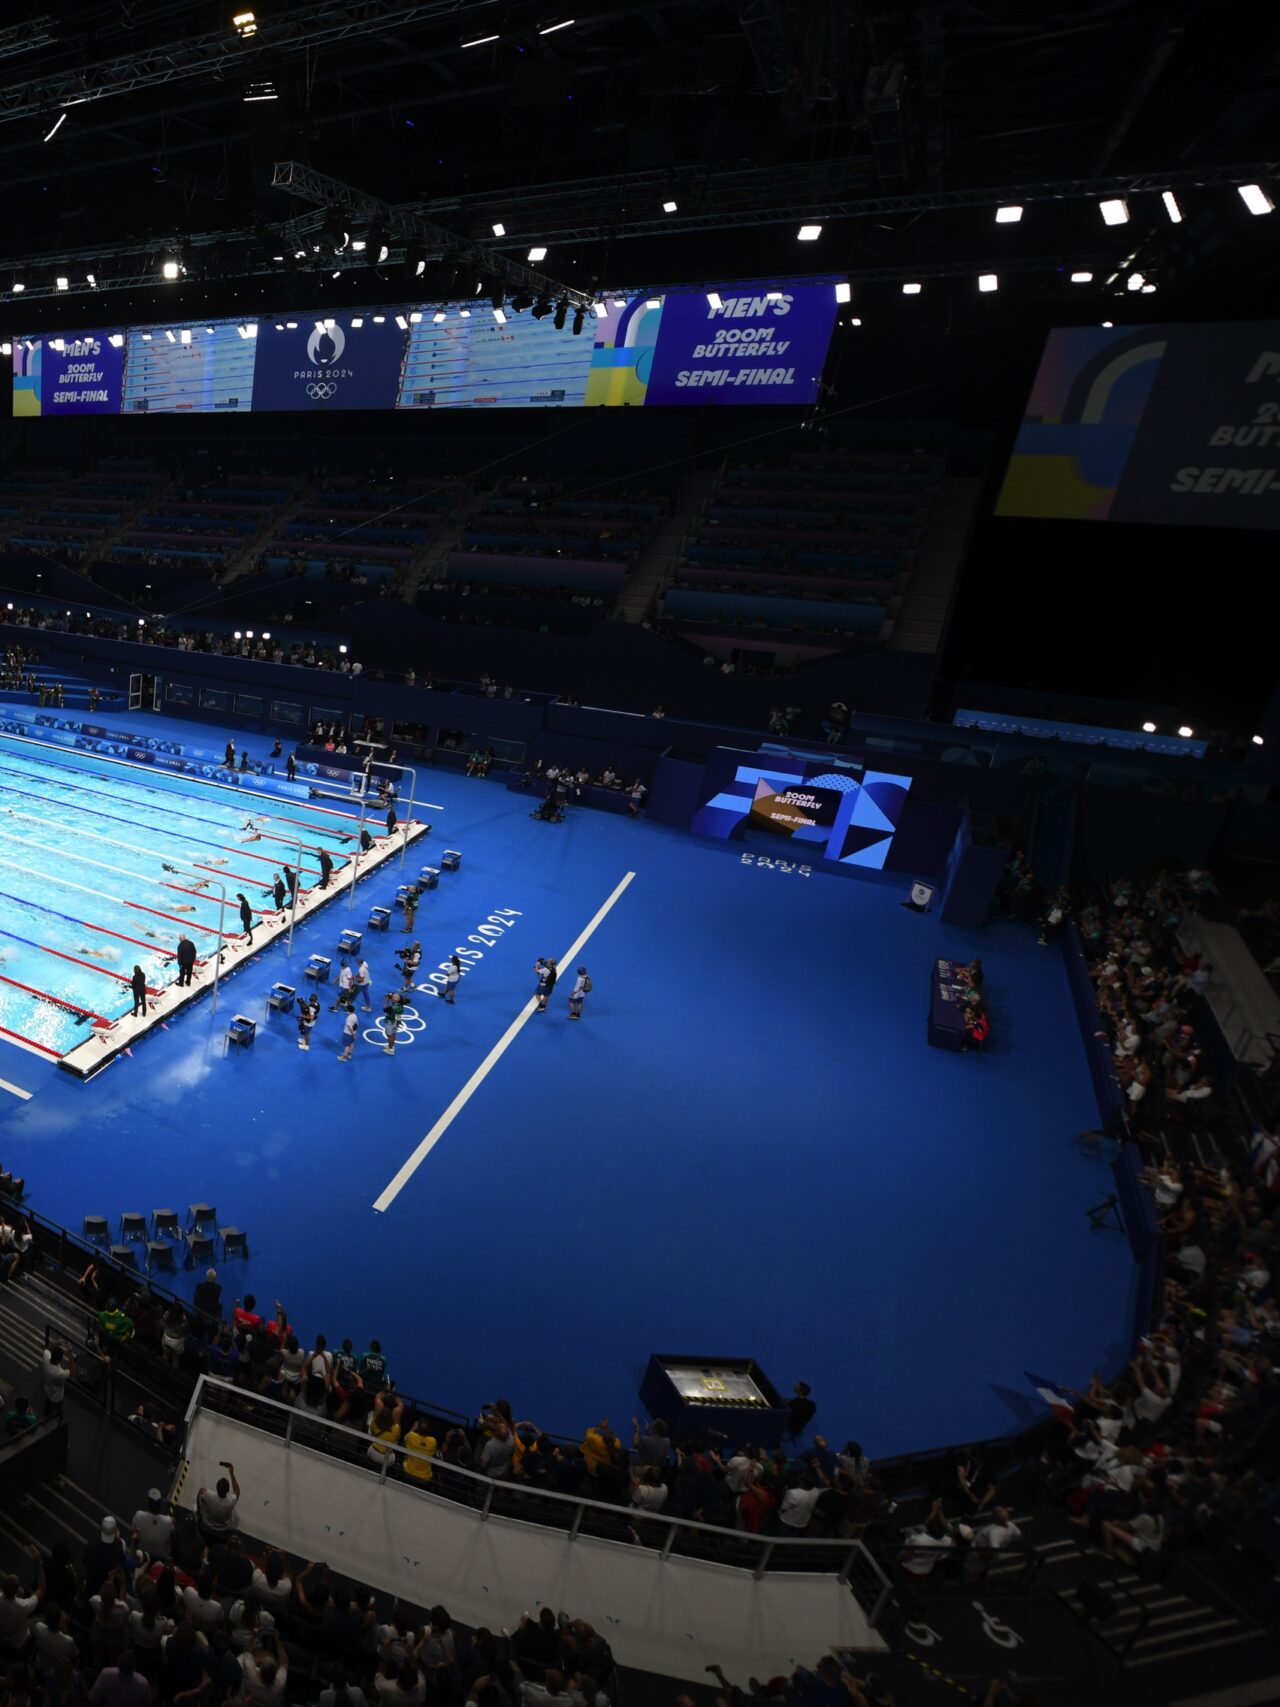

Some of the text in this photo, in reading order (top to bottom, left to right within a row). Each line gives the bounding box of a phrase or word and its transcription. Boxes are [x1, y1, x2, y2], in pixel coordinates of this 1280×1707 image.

[707, 295, 794, 319] MEN'S
[713, 327, 775, 343] 200M
[62, 341, 101, 357] MEN'S
[692, 341, 790, 358] BUTTERFLY
[67, 363, 95, 374] 200M
[294, 369, 353, 379] PARIS 2024
[59, 372, 103, 383] BUTTERFLY
[675, 367, 795, 387] SEMI-FINAL
[53, 390, 108, 403] SEMI-FINAL
[1208, 425, 1280, 447] BUT
[774, 796, 822, 810] BUTTERFLY
[785, 791, 815, 802] 200M
[770, 812, 816, 826] SEMI-FINAL
[742, 853, 812, 872] PARIS
[416, 908, 523, 997] PARIS 2024
